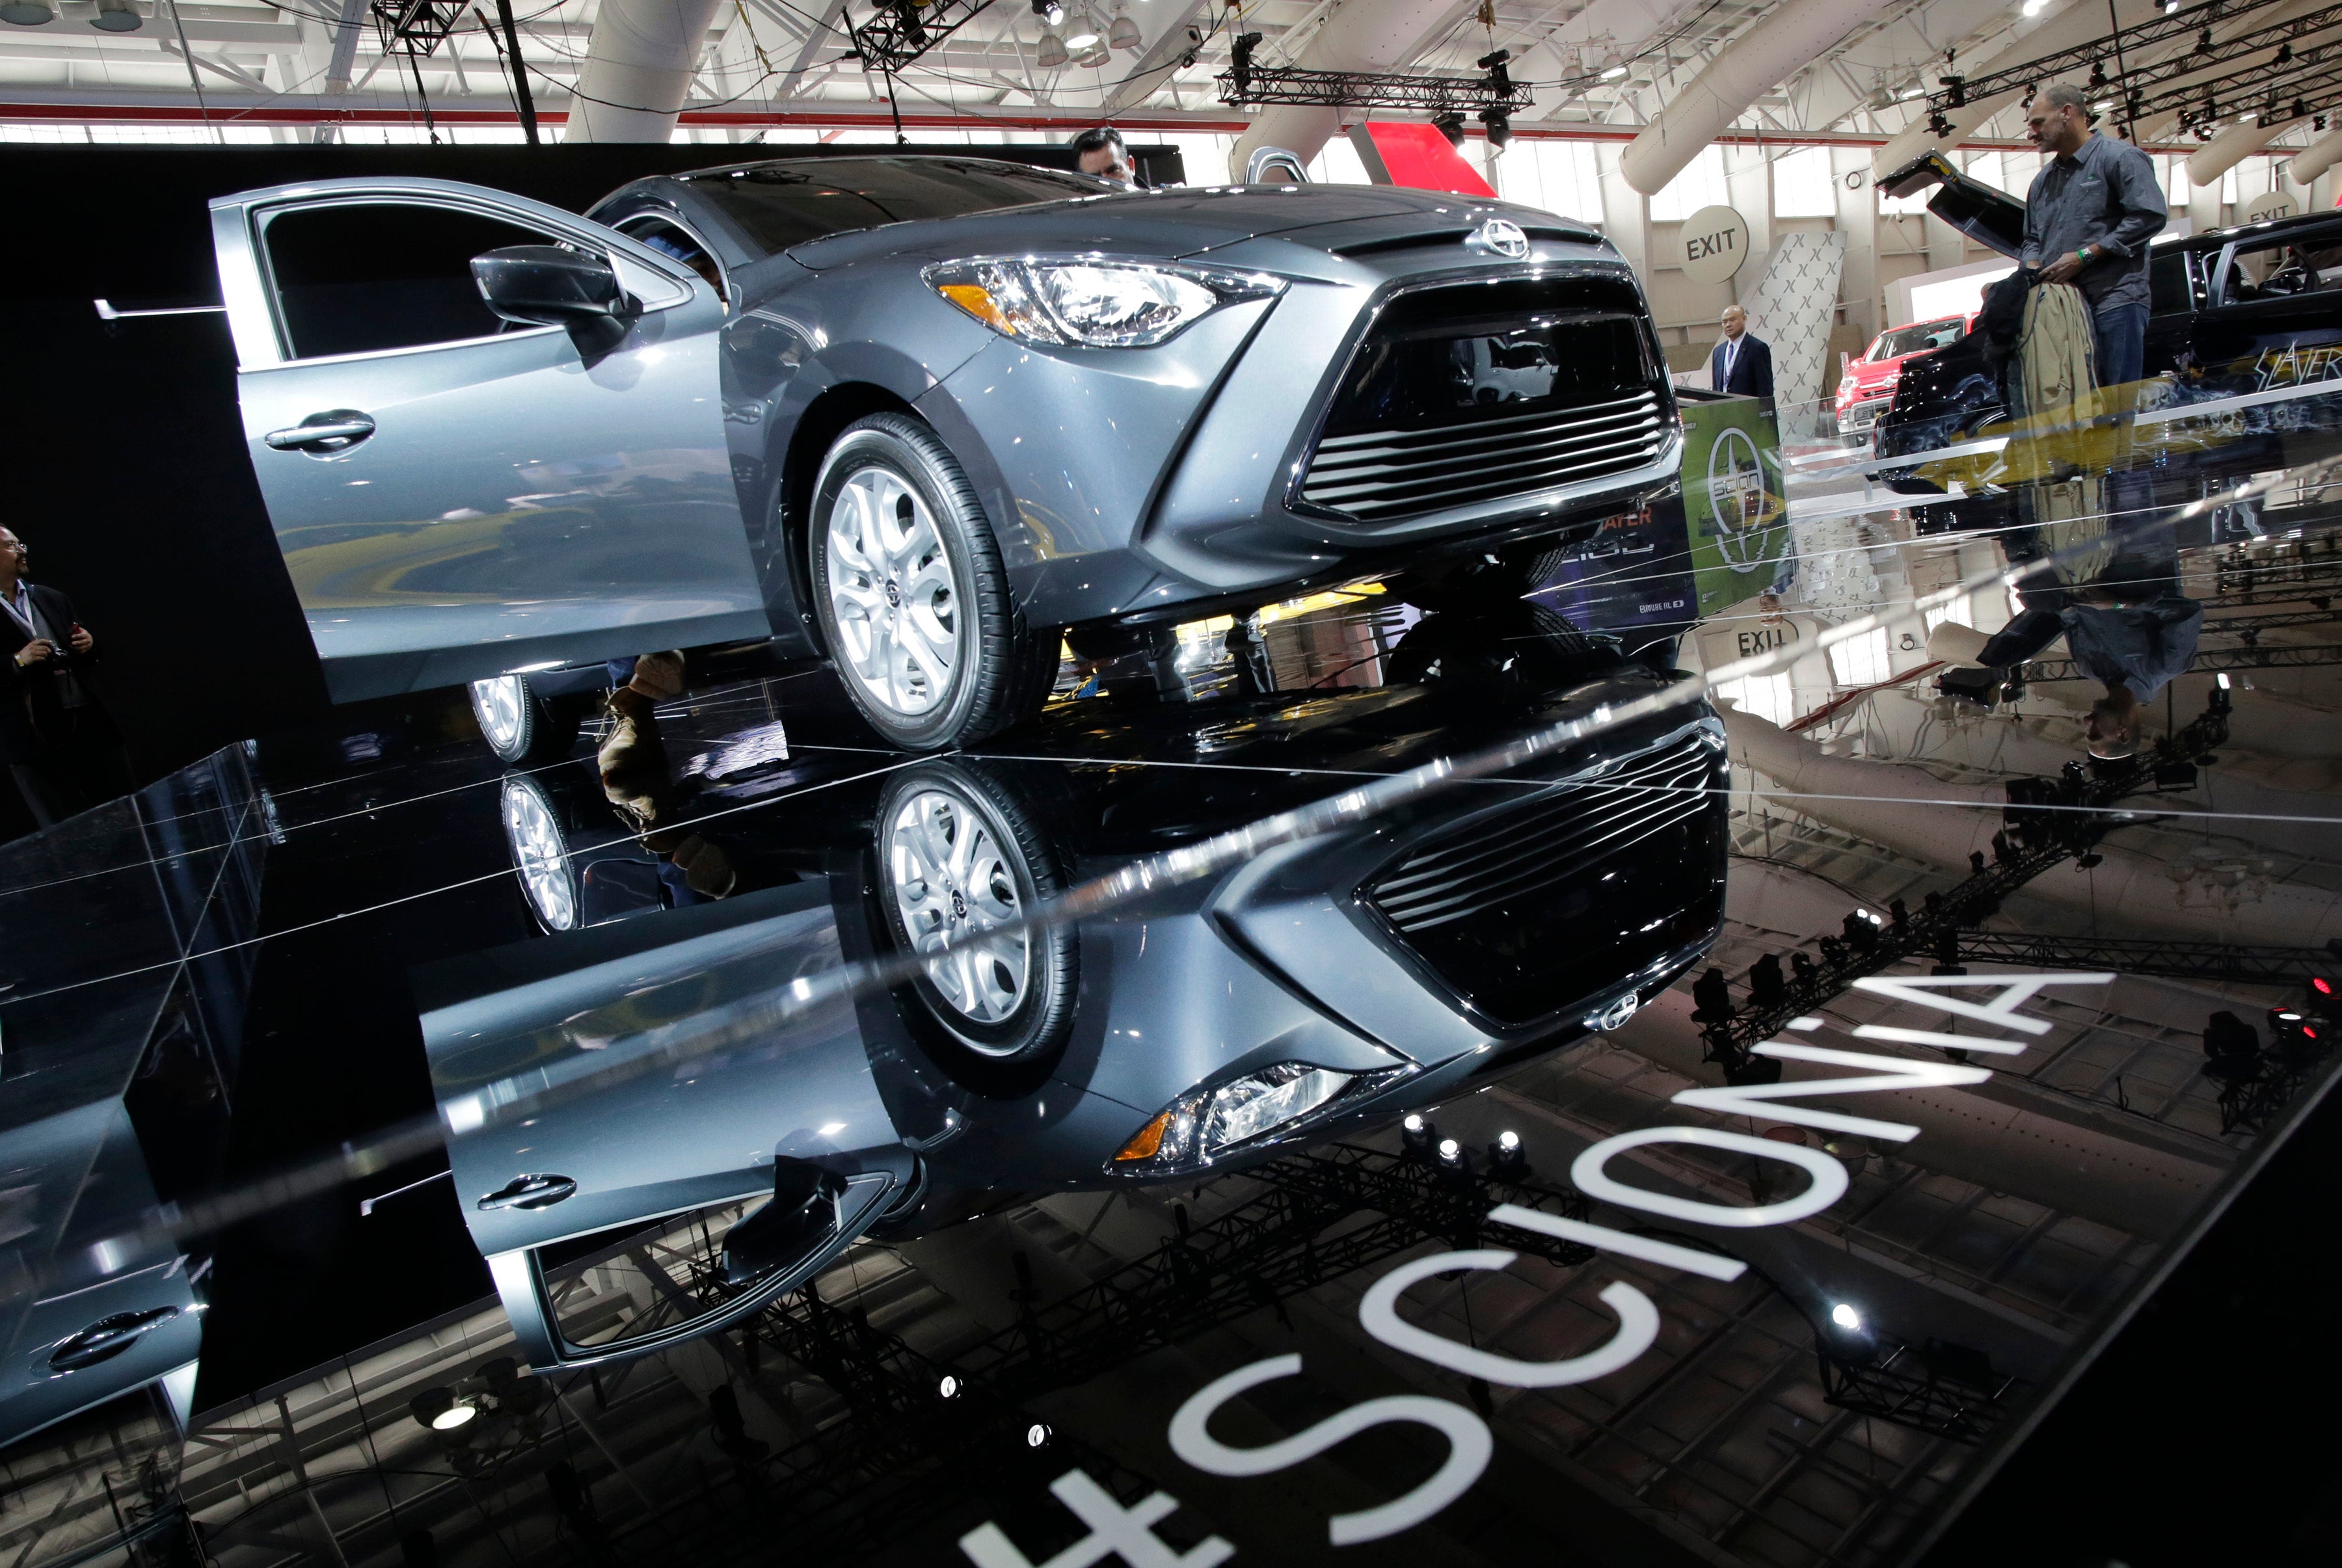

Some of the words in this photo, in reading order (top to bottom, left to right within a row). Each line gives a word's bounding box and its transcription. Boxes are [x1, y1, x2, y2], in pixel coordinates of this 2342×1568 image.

[1686, 228, 1736, 261] EXIT
[2253, 339, 2342, 393] SLAYER
[1713, 473, 1759, 497] SCION
